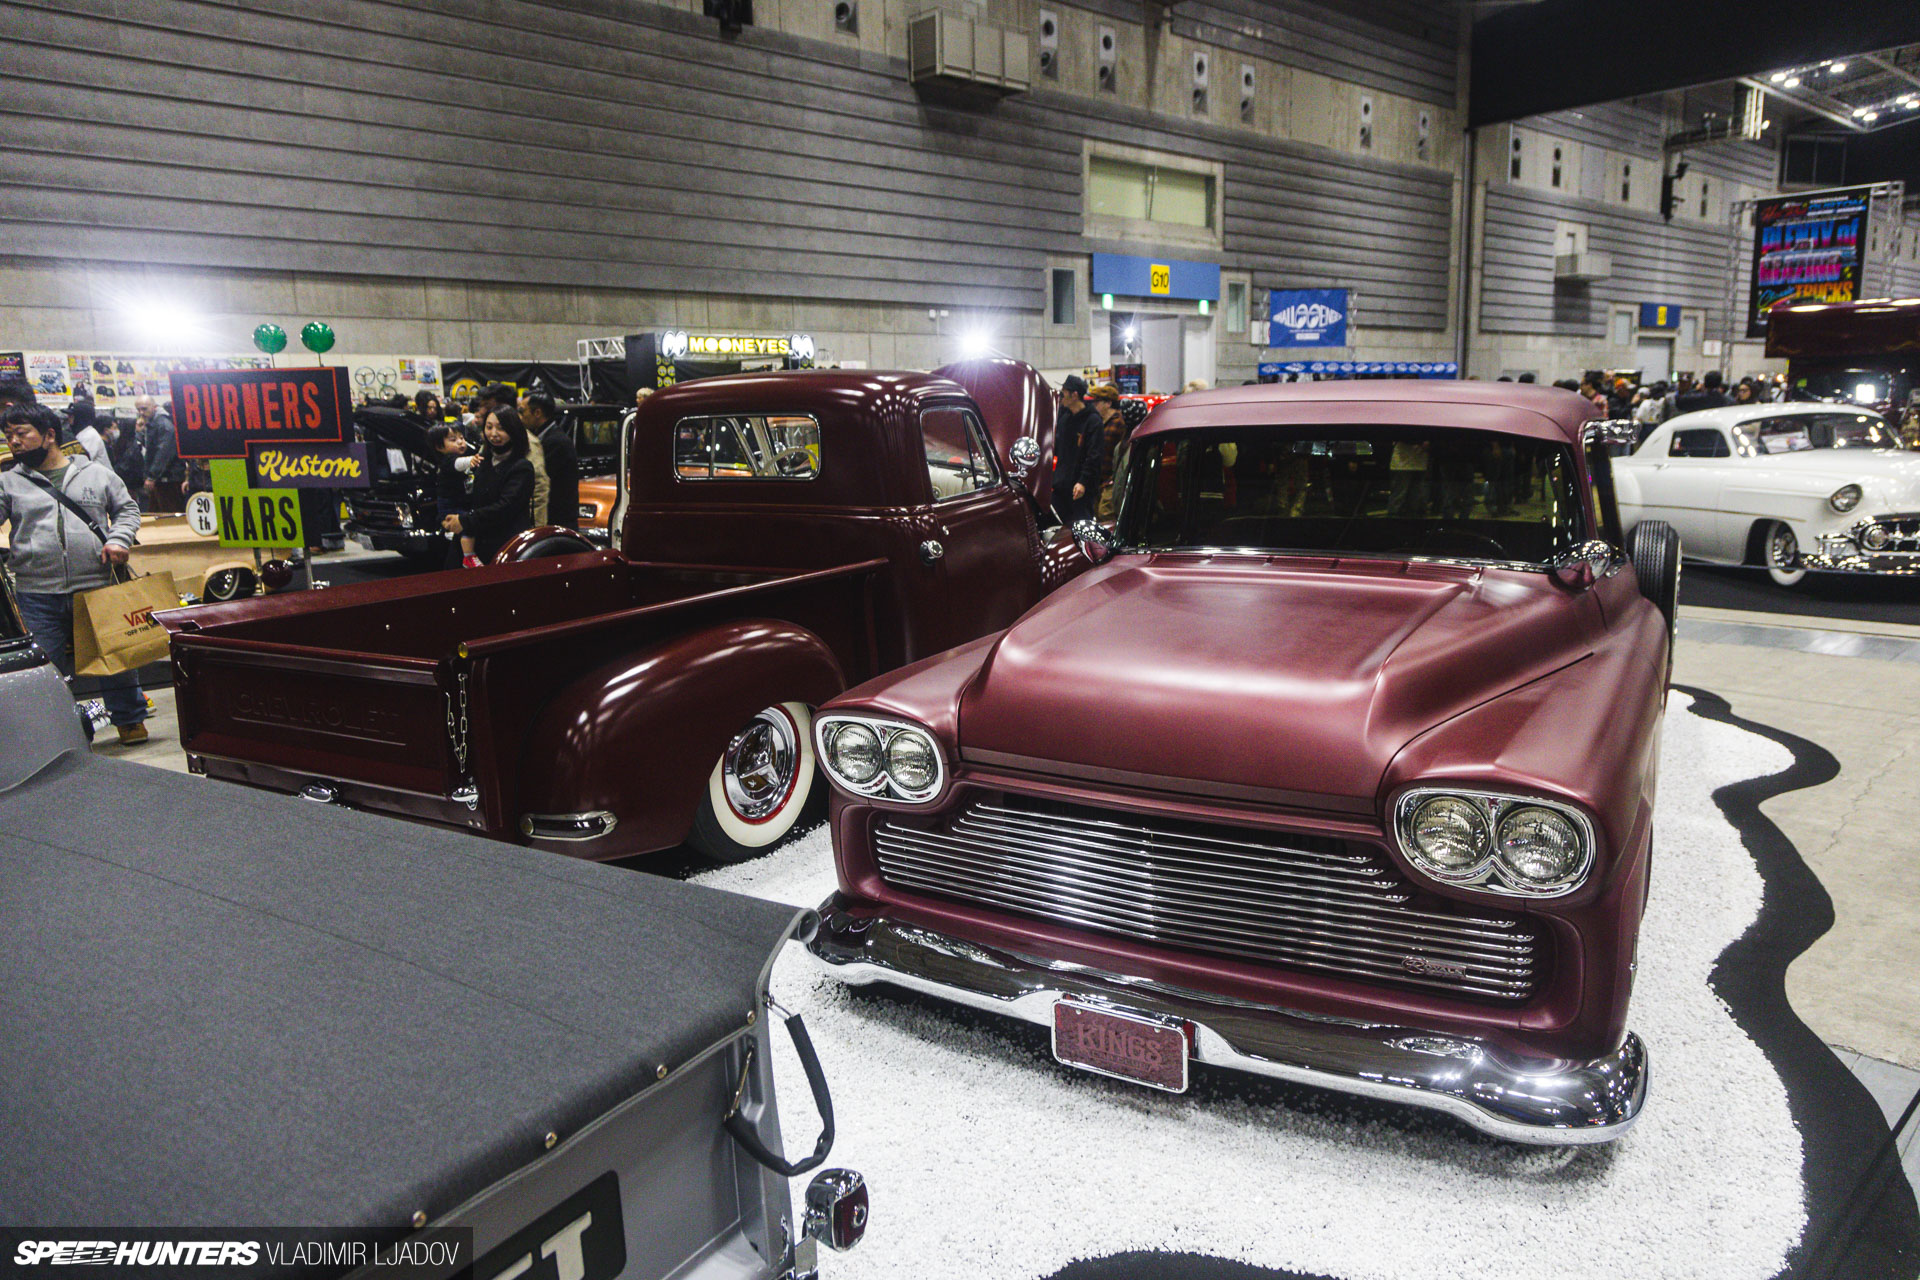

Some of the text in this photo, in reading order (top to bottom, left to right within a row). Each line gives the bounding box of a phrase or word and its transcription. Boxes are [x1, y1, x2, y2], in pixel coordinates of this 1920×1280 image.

[1151, 271, 1169, 288] G10
[688, 336, 790, 354] MOONEYES
[182, 381, 322, 431] BURNERS
[258, 450, 361, 482] Kustom
[196, 498, 210, 514] 20
[198, 516, 211, 530] th
[219, 496, 298, 541] KARS
[123, 606, 154, 627] VAN
[1077, 1023, 1163, 1064] KINGS
